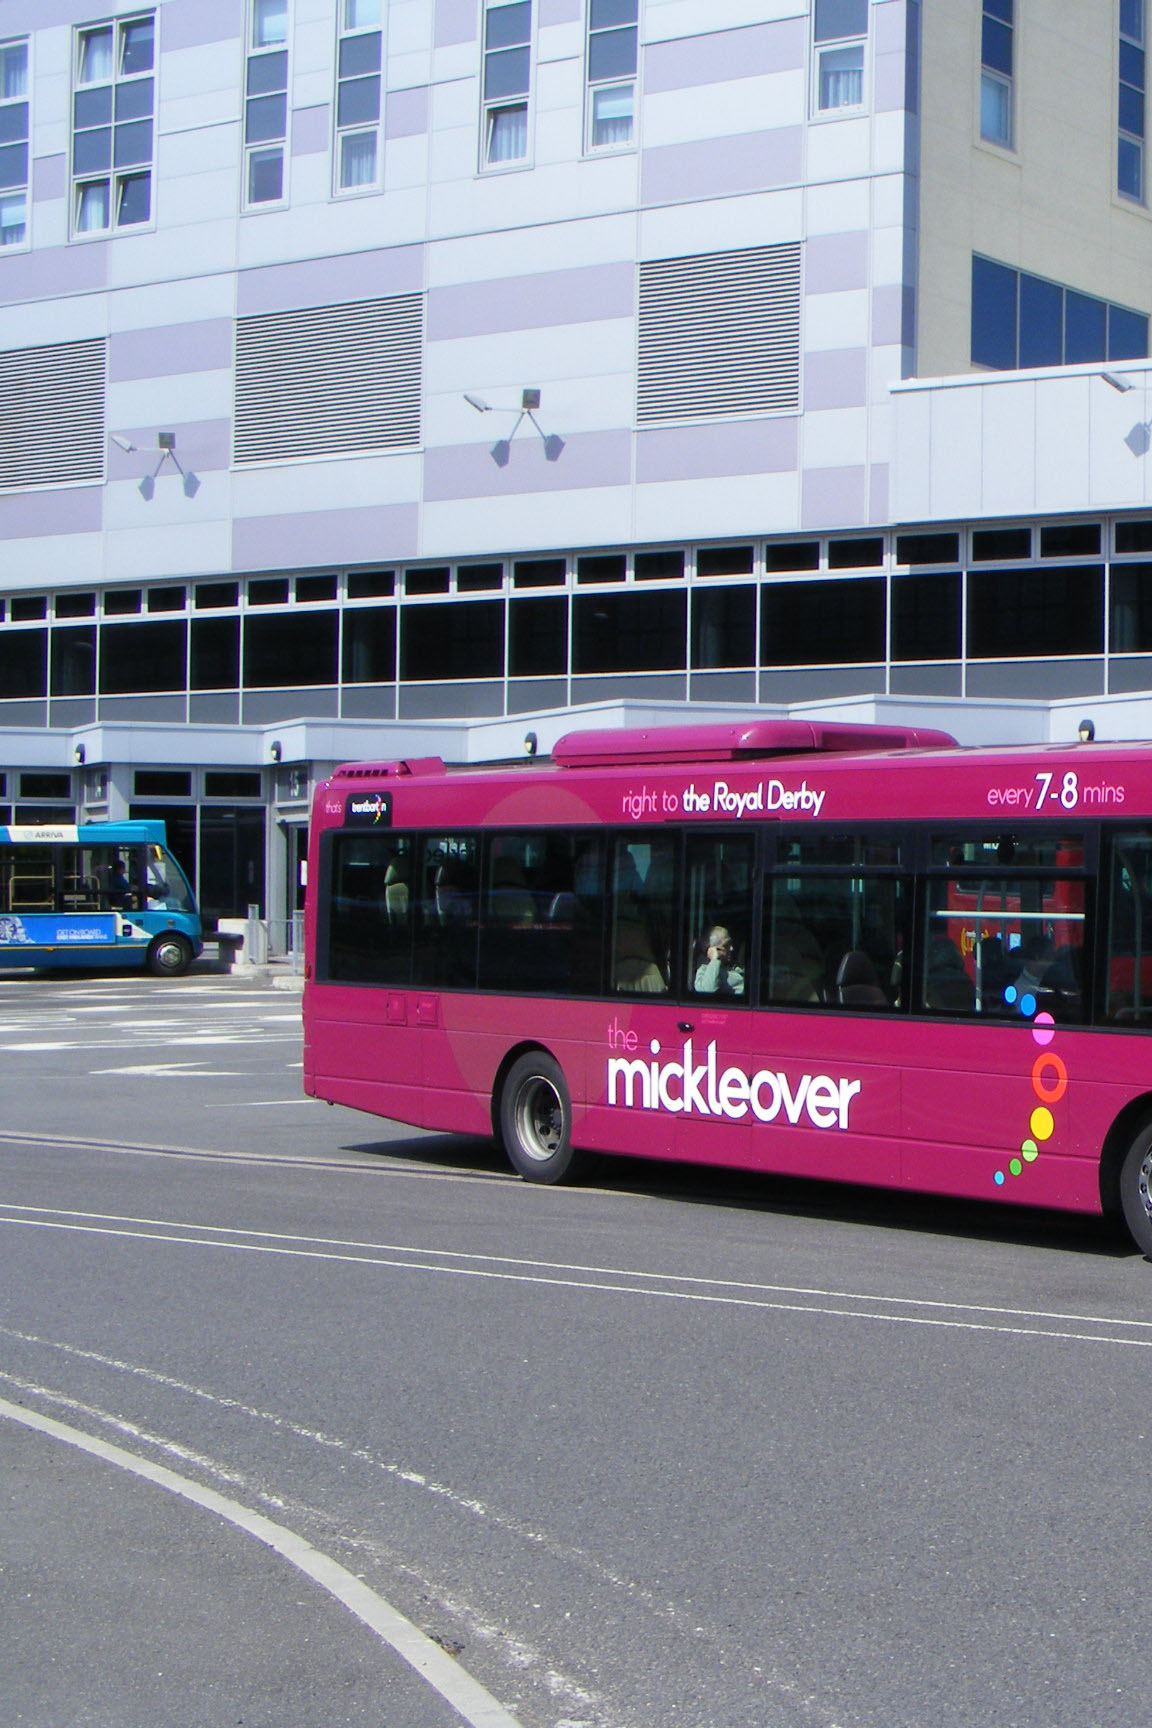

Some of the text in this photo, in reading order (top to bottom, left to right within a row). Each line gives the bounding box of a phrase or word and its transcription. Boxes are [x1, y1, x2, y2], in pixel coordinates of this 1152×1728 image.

[325, 800, 342, 814] that's
[622, 779, 826, 820] right to the Royal Derby
[987, 771, 1125, 810] every 7-8 mins
[35, 831, 64, 839] ARRIVA
[607, 1016, 639, 1051] the
[607, 1037, 861, 1130] mickleover
